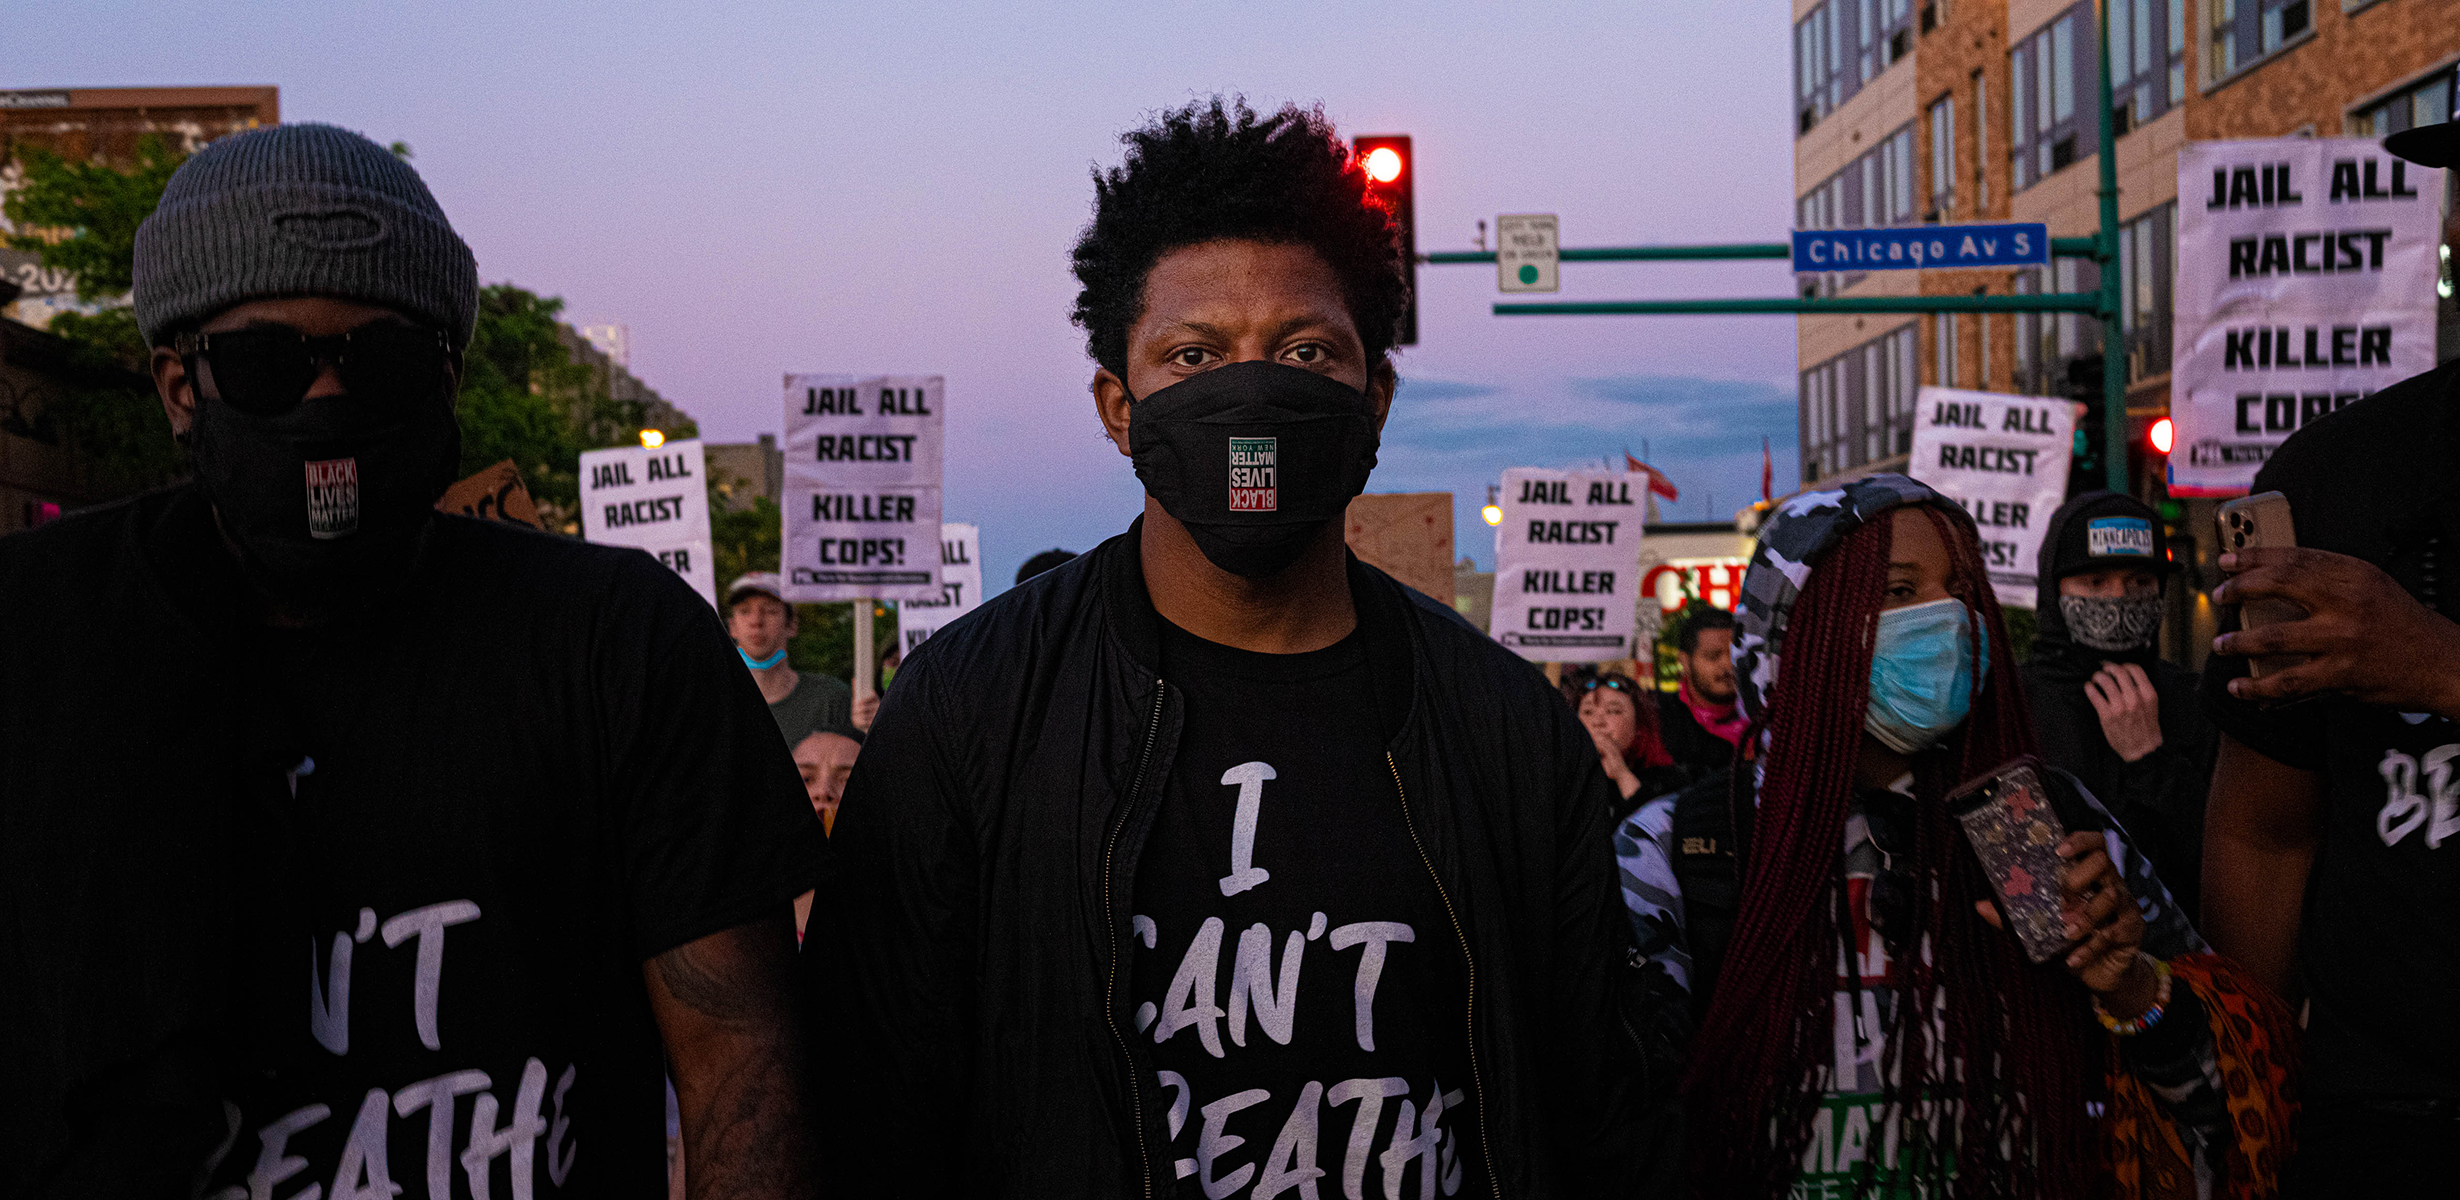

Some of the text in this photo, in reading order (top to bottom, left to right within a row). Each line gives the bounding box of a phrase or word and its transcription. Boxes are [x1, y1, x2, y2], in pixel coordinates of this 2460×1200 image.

[2207, 158, 2418, 212] JAIL ALL
[1809, 232, 2032, 267] Chicago Av S
[2229, 228, 2393, 281] RACIST
[2224, 325, 2393, 371] KILLER
[802, 388, 931, 417] JAIL ALL
[2235, 391, 2372, 436] COP
[1931, 402, 2055, 435] JAIL ALL
[816, 435, 918, 462] RACIST
[1231, 444, 1274, 452] NEW YORK
[1231, 451, 1274, 466] MATTER
[1940, 445, 2039, 476] RACIST
[310, 461, 356, 487] BLACK
[591, 455, 692, 490] JAIL ALL
[1231, 467, 1274, 488] LIVES
[311, 485, 355, 508] LIVES
[1232, 490, 1274, 508] BLACK
[1518, 480, 1634, 505] JAIL ALL
[605, 497, 683, 529] RACIST
[812, 494, 916, 523] KILLER
[1528, 520, 1619, 545] RACIST
[820, 538, 905, 566] COPS!
[1523, 570, 1616, 594] KILLER
[1528, 607, 1605, 631] COPS!
[1219, 761, 1277, 897] I
[311, 899, 482, 1056] N'T
[193, 1057, 577, 1200] EATHE
[1157, 1069, 1466, 1200] EATH
